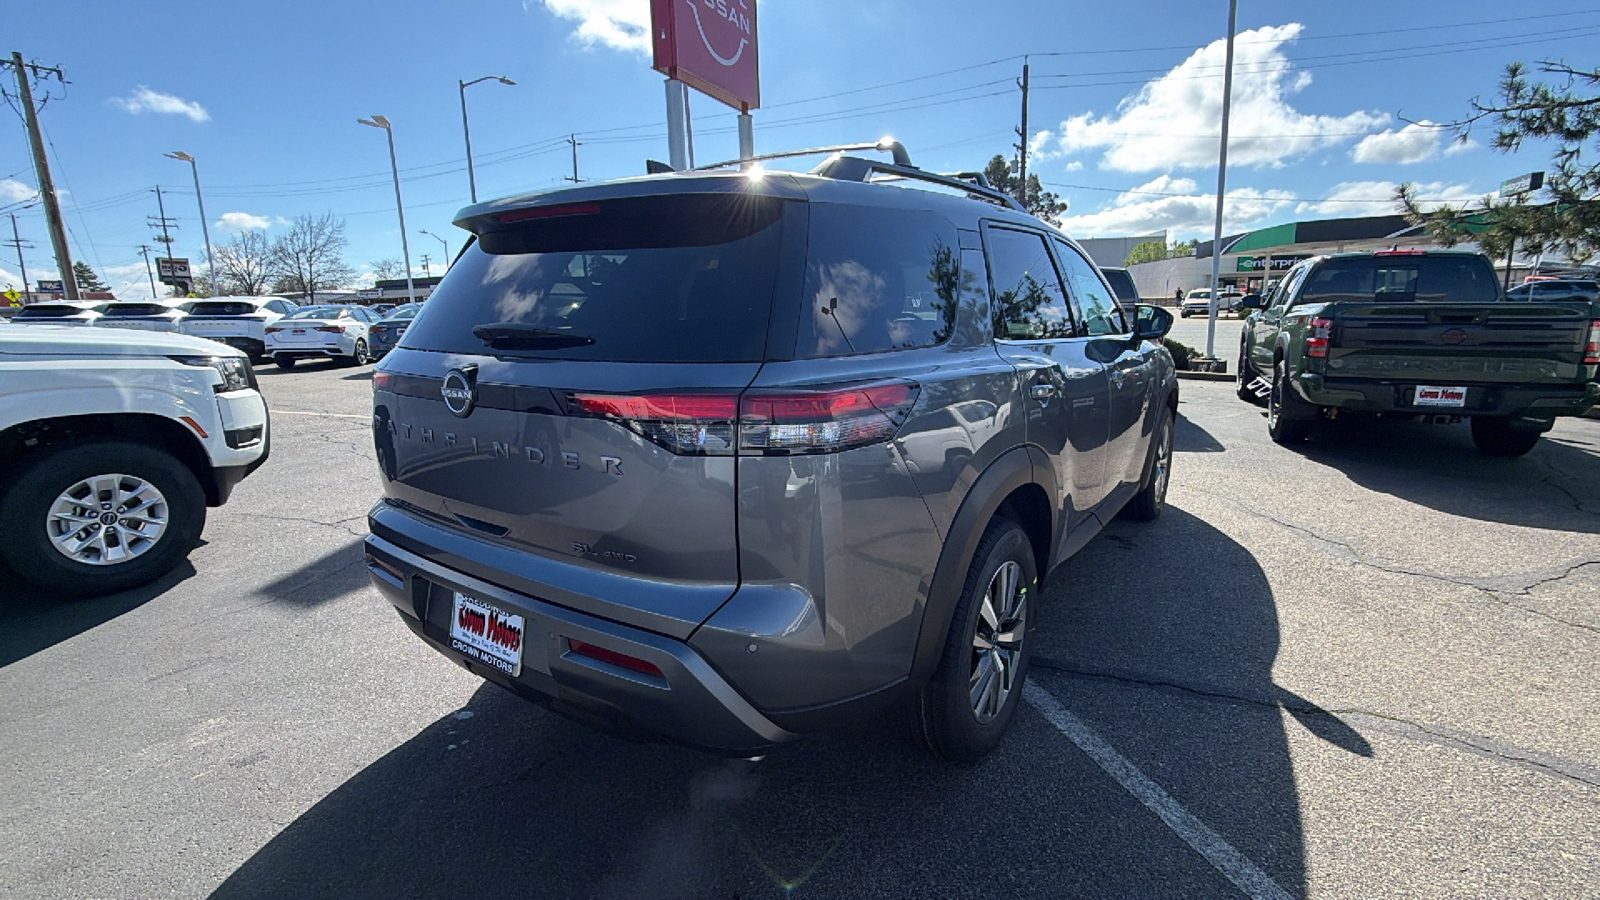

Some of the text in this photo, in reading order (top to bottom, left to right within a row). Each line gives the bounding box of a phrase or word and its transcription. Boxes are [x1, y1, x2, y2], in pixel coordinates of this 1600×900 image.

[374, 414, 624, 476] PATHFINDER
[571, 541, 599, 556] SL
[486, 611, 521, 652] Motors
[452, 640, 480, 658] CROWN
[480, 651, 513, 673] MOTORS
